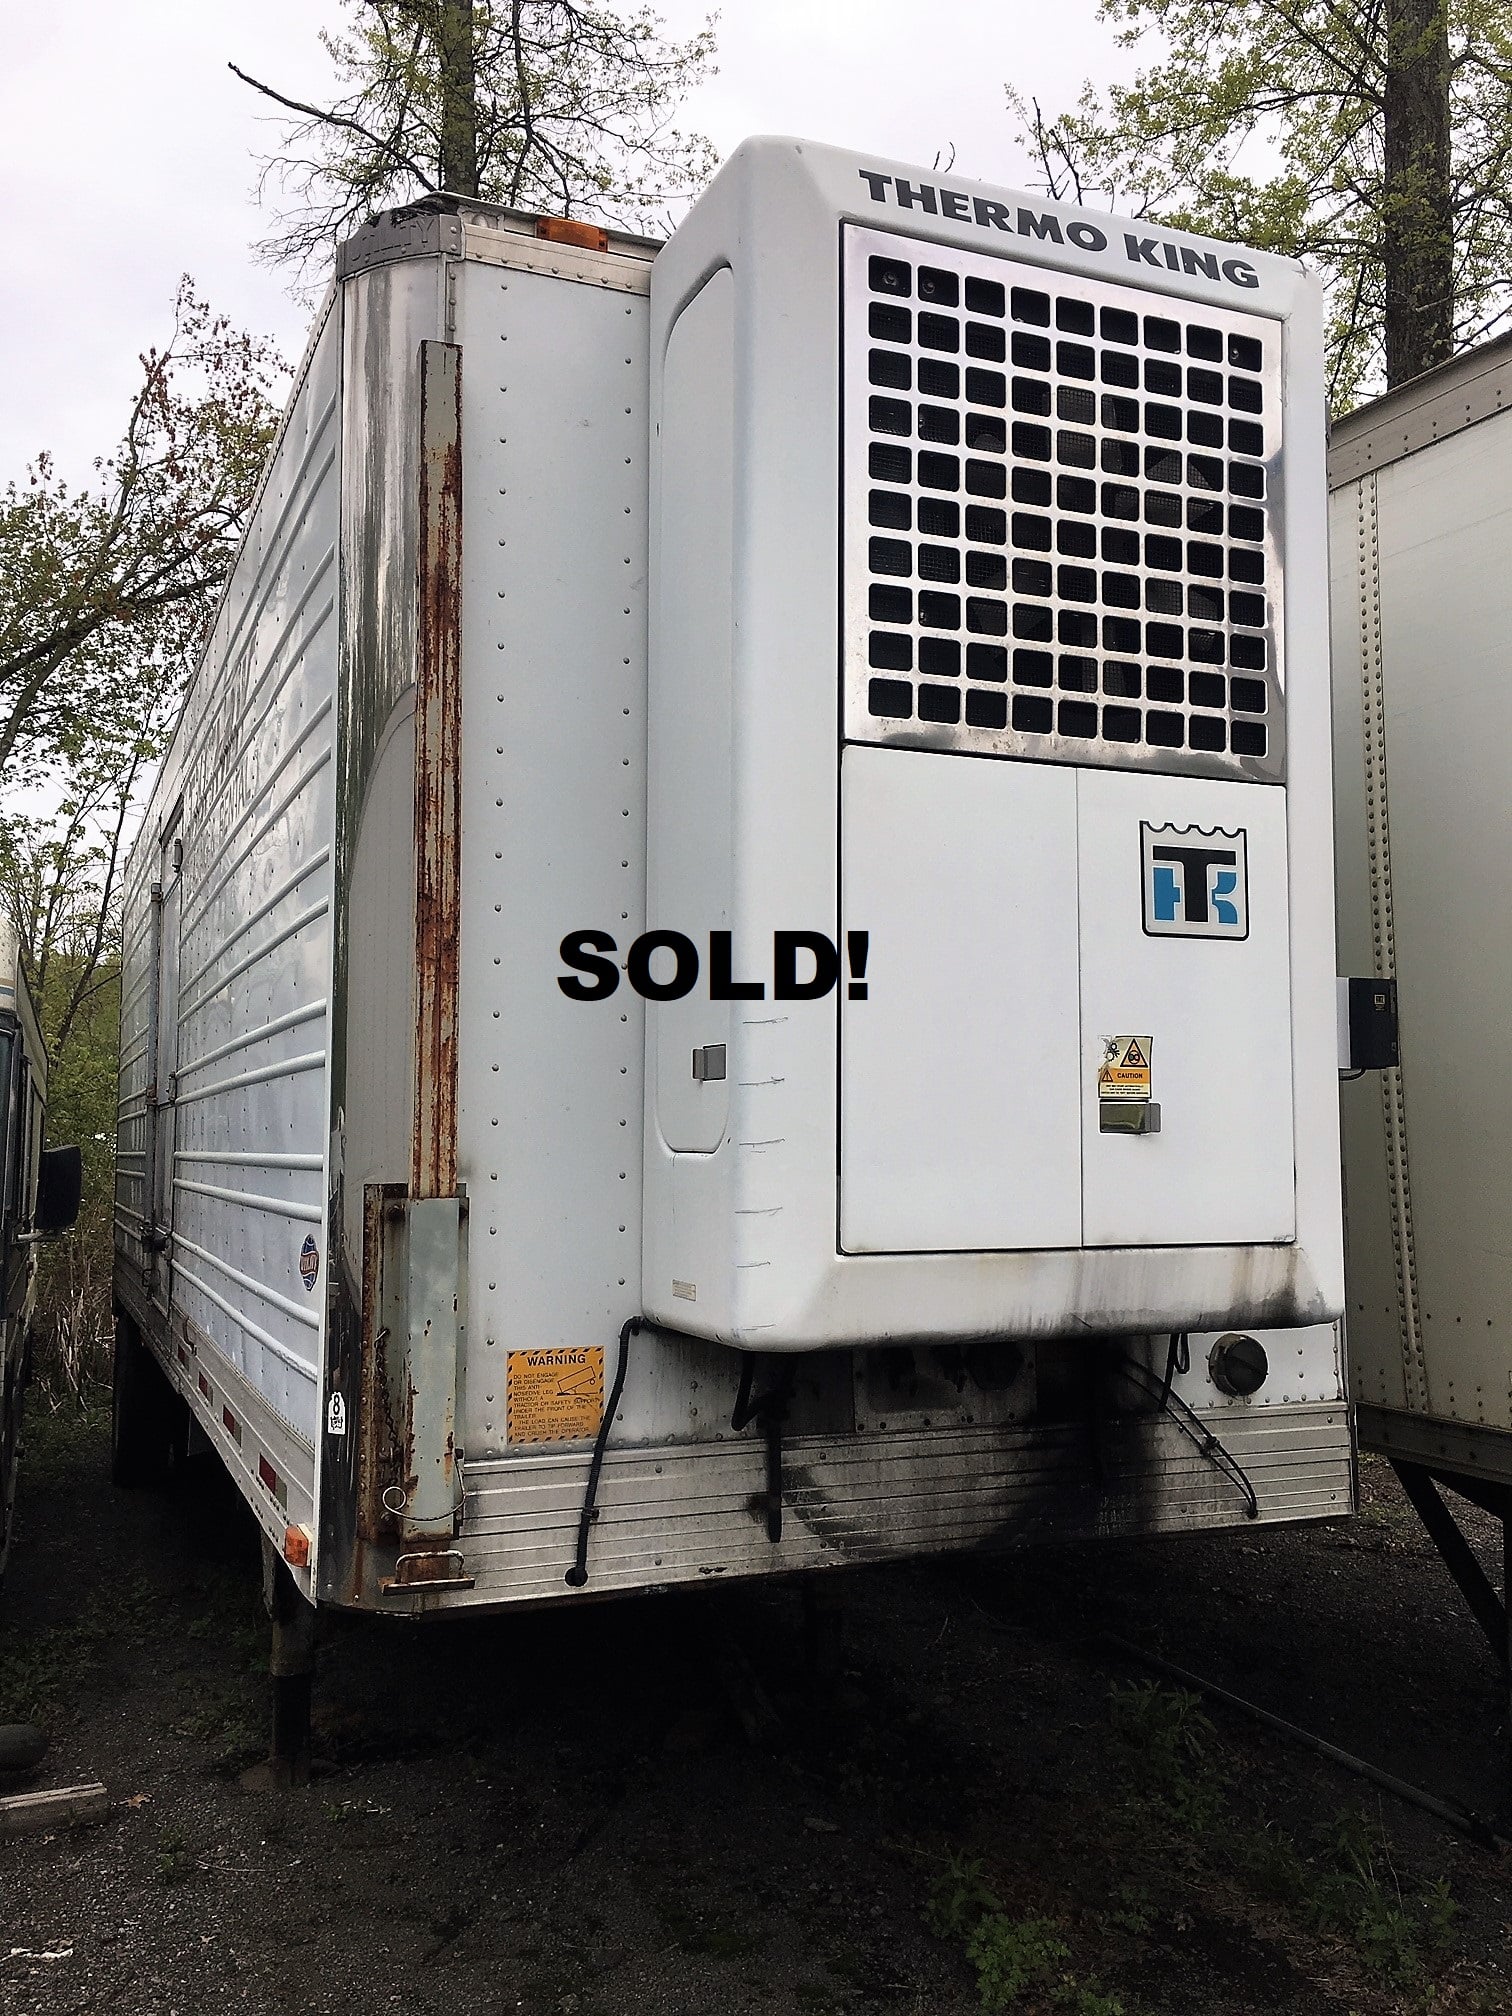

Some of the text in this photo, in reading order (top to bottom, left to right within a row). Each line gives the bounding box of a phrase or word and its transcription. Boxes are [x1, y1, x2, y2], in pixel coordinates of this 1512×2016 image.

[858, 169, 1260, 289] THERMO KING
[527, 1354, 586, 1366] WARNING
